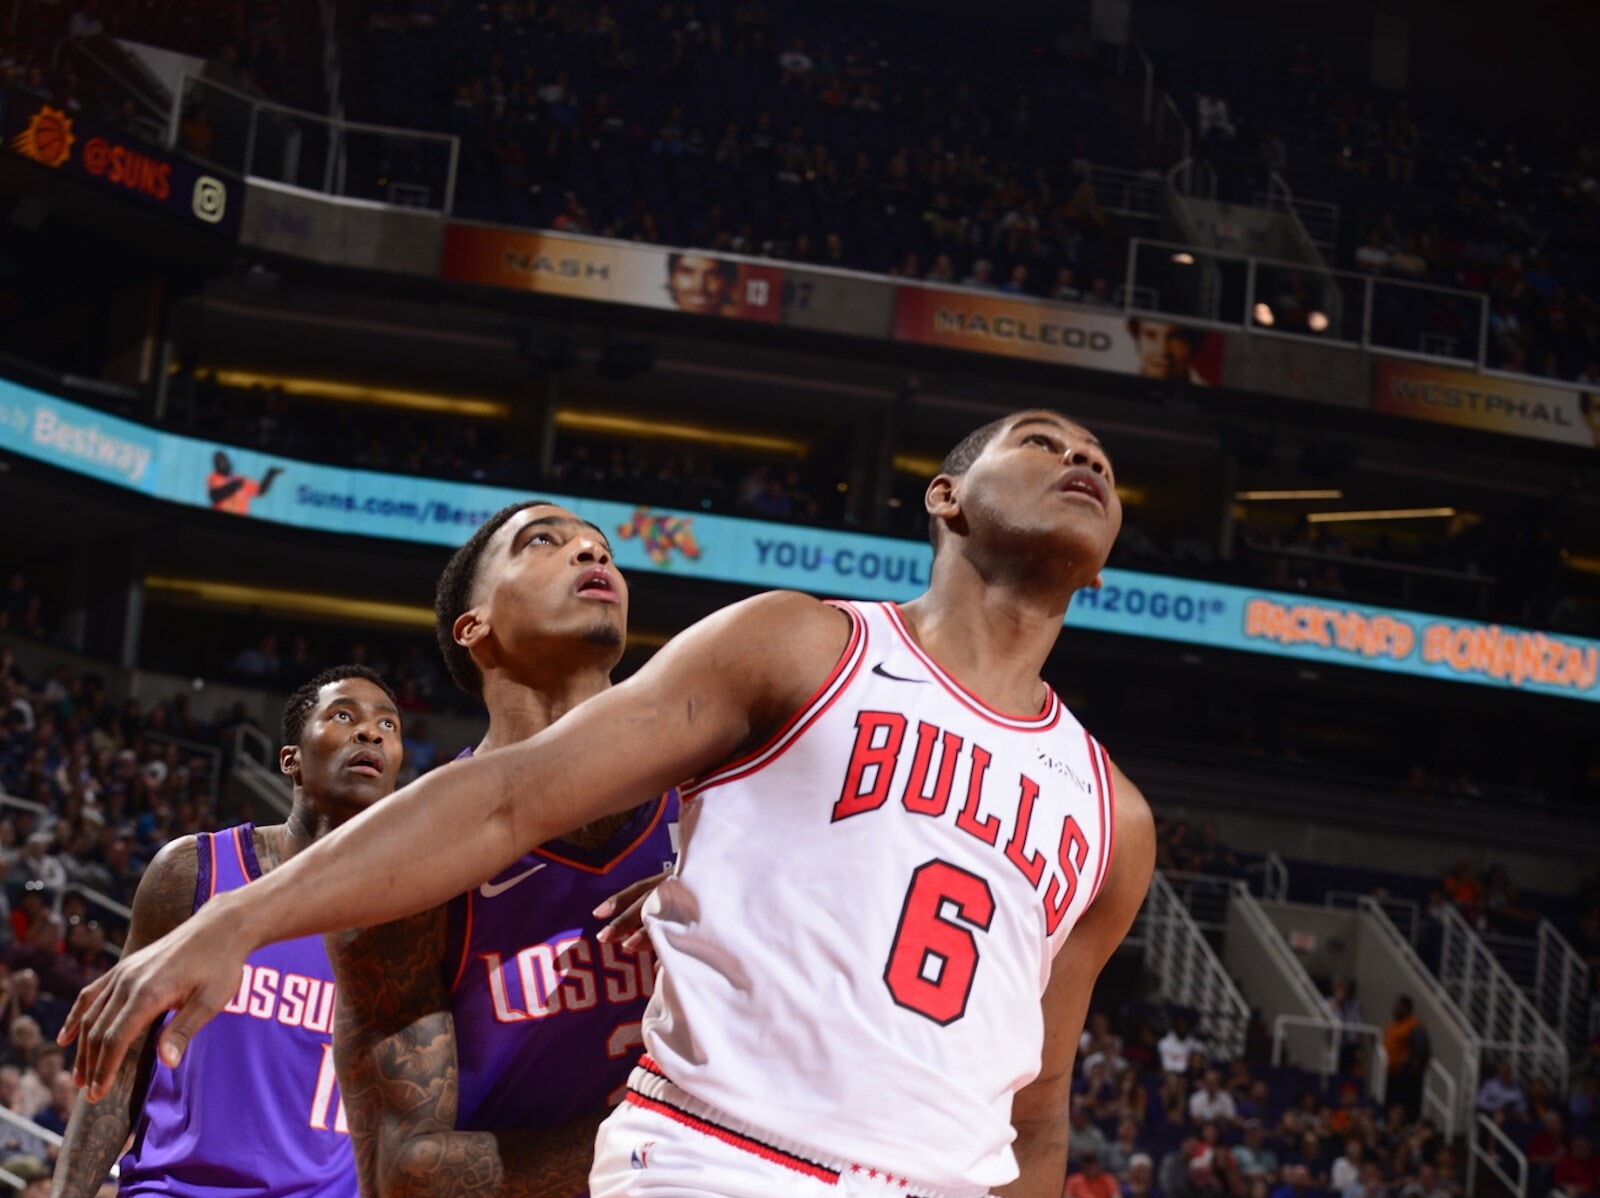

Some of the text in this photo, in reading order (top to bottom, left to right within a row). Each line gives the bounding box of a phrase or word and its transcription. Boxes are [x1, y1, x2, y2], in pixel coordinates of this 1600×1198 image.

[83, 137, 171, 200] @SUNS
[504, 251, 611, 281] NASH
[935, 309, 1113, 352] MACLEOD
[1390, 376, 1572, 427] WESTPHAL
[33, 408, 152, 480] Bestway
[755, 538, 821, 572] YOU
[833, 550, 925, 586] COUL
[1244, 598, 1414, 660] BACKYARD
[830, 709, 1090, 937] BULLS
[882, 857, 996, 1027] 6
